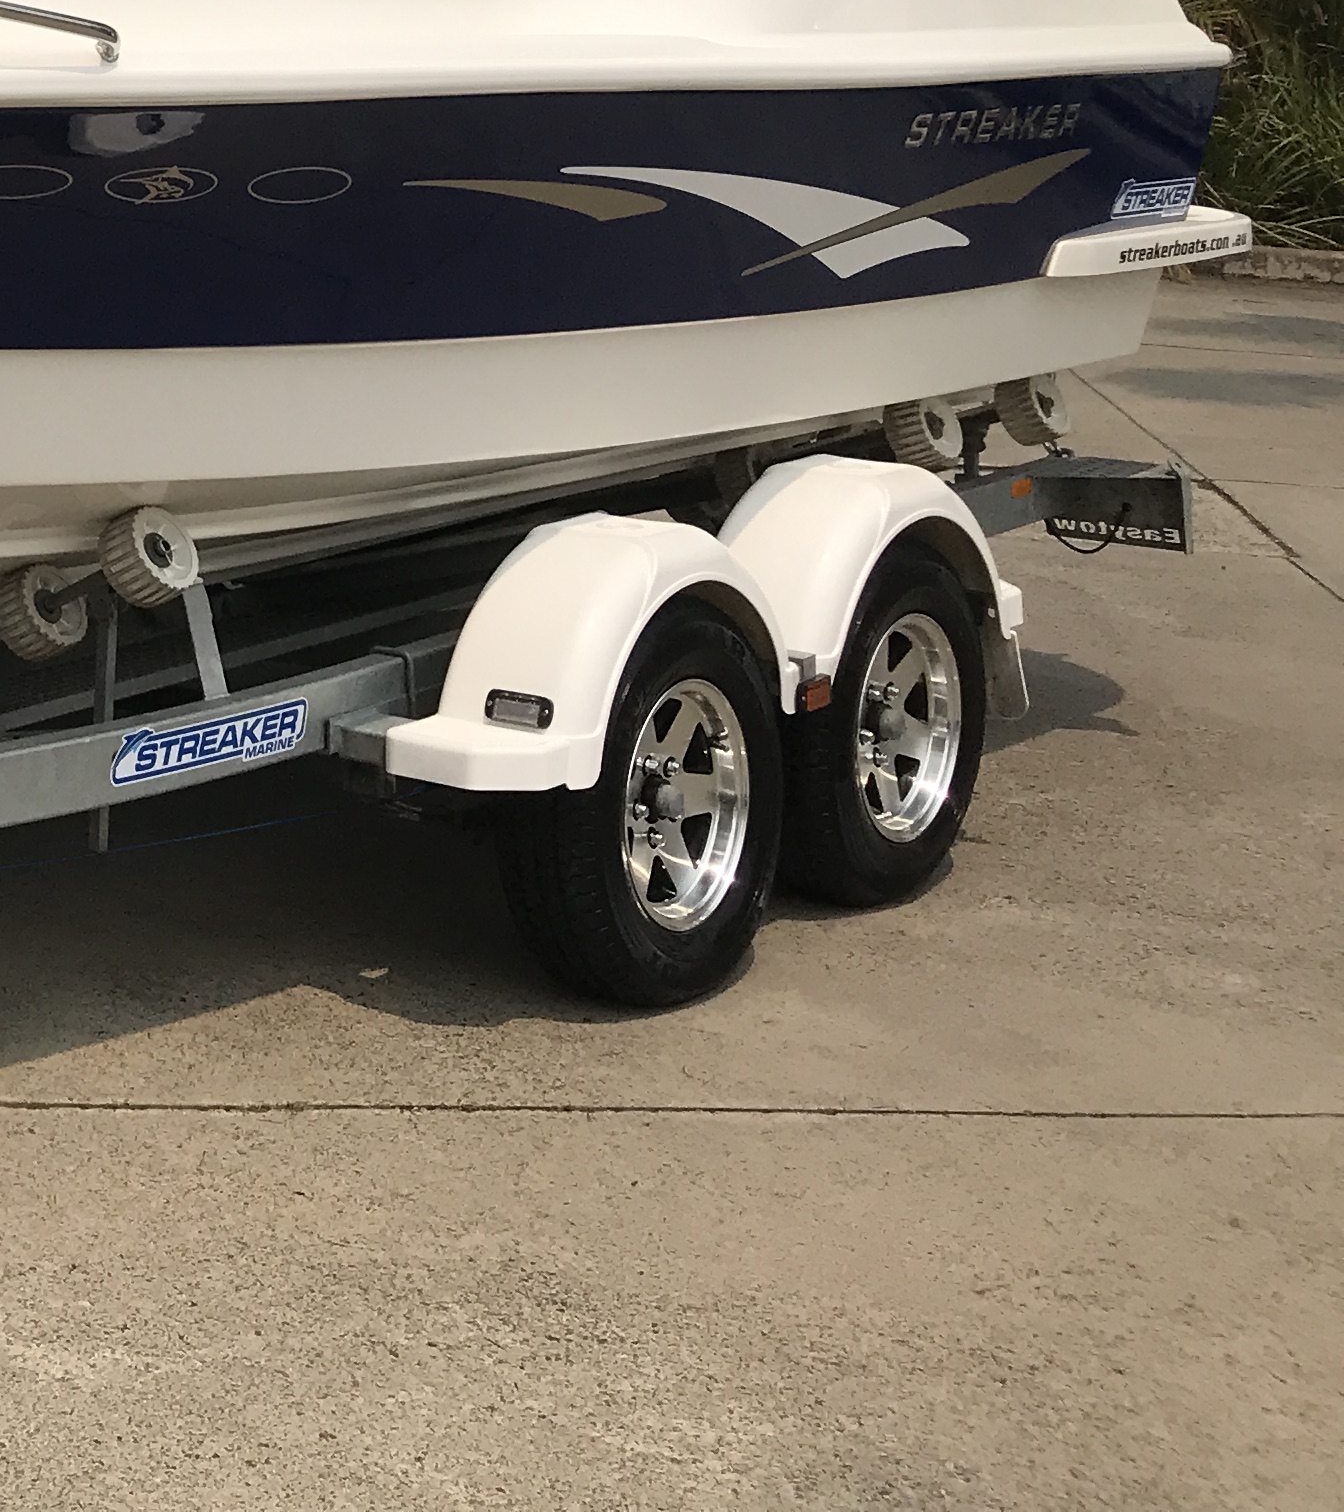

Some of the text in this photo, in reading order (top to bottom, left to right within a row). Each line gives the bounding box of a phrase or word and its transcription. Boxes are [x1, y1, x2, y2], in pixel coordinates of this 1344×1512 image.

[905, 102, 1082, 149] STREAKER
[1121, 185, 1191, 211] STREAKER
[135, 708, 299, 772] STREAKER
[244, 738, 295, 759] MARINE
